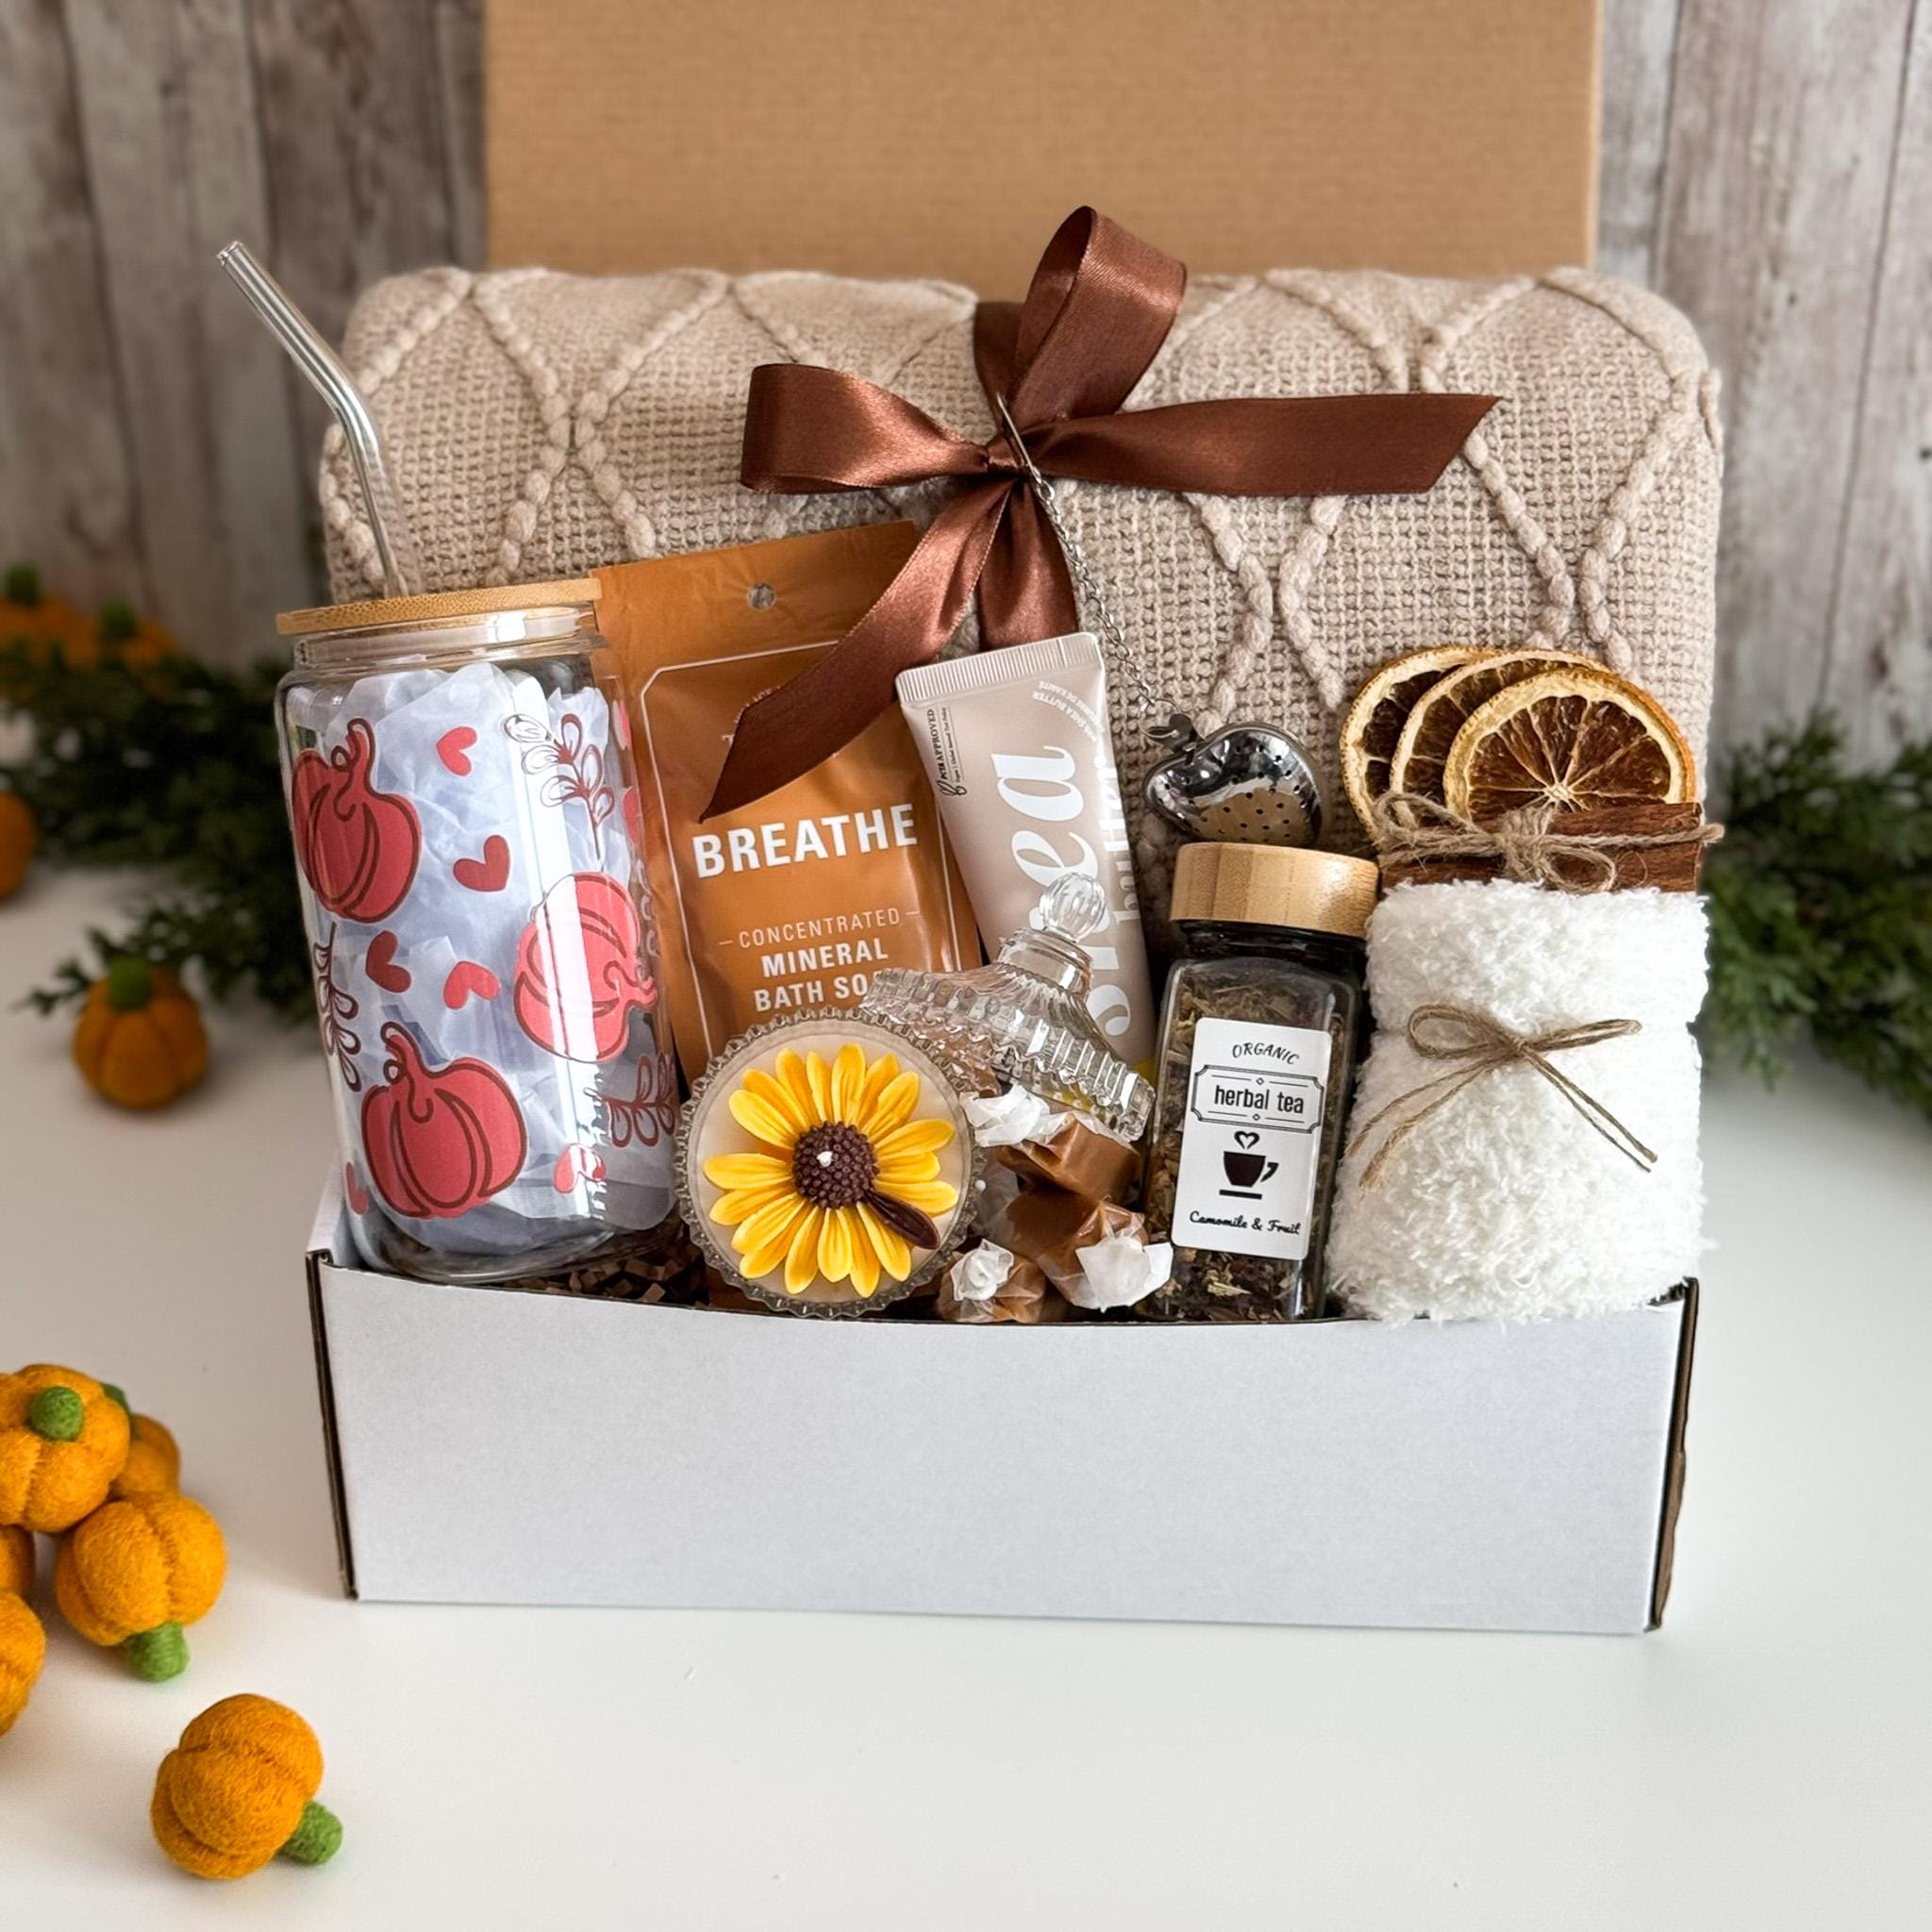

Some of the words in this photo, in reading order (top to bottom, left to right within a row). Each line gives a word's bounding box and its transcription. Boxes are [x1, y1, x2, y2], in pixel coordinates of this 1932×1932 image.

[926, 708, 944, 761] APPROVED
[691, 804, 919, 879] BREATHE
[739, 908, 900, 949] CONCENTRATED
[761, 938, 889, 978] MINERAL
[754, 979, 824, 1012] BATH
[833, 971, 881, 1000] SO
[1232, 1041, 1301, 1065] ORGANIC
[1214, 1085, 1270, 1110] herbal
[1277, 1093, 1305, 1114] tea
[1190, 1210, 1247, 1230] Camomile
[1251, 1218, 1264, 1231] &
[1267, 1219, 1301, 1236] Fruit
